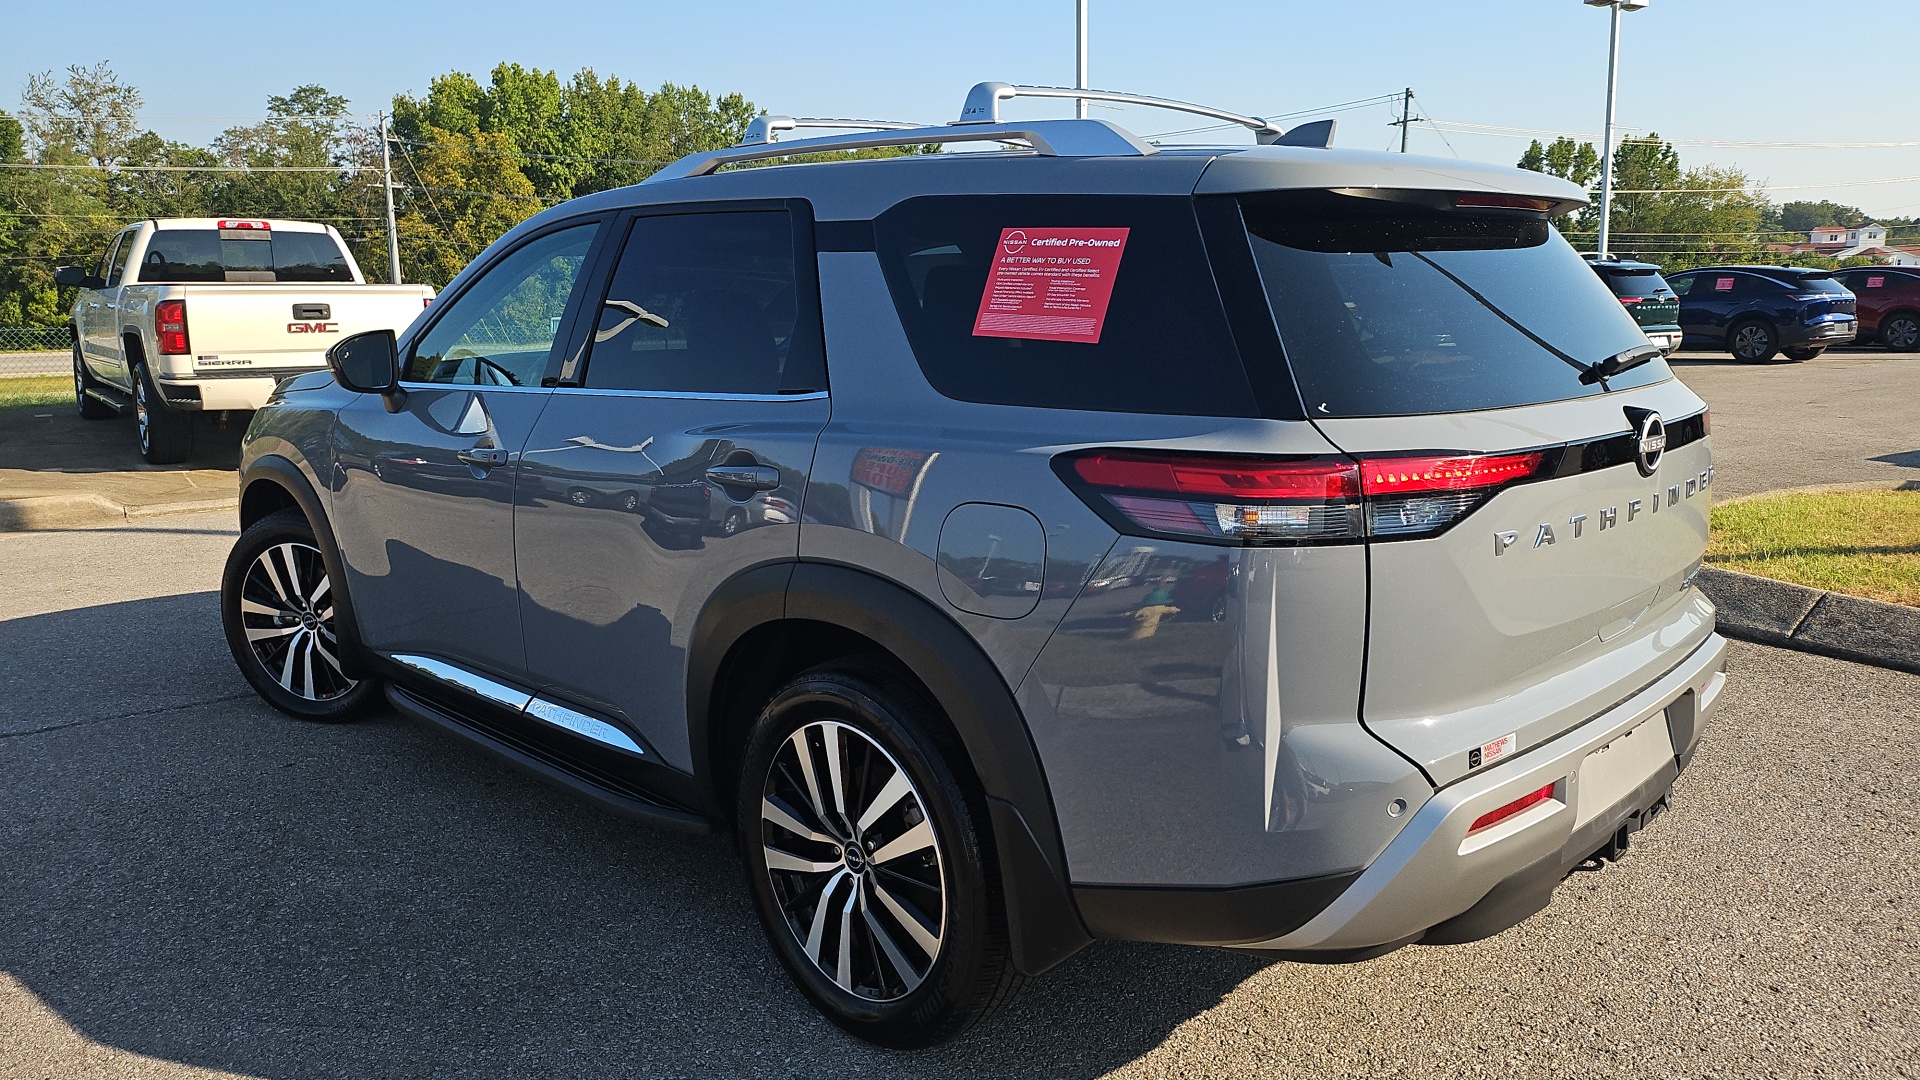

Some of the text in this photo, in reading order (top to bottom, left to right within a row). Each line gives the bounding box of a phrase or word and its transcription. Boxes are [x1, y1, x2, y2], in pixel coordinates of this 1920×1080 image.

[1031, 238, 1120, 247] Certified Pre-Owned
[288, 322, 338, 333] GMC
[532, 701, 609, 738] PATHFINDER
[1484, 748, 1502, 758] NISSAN
